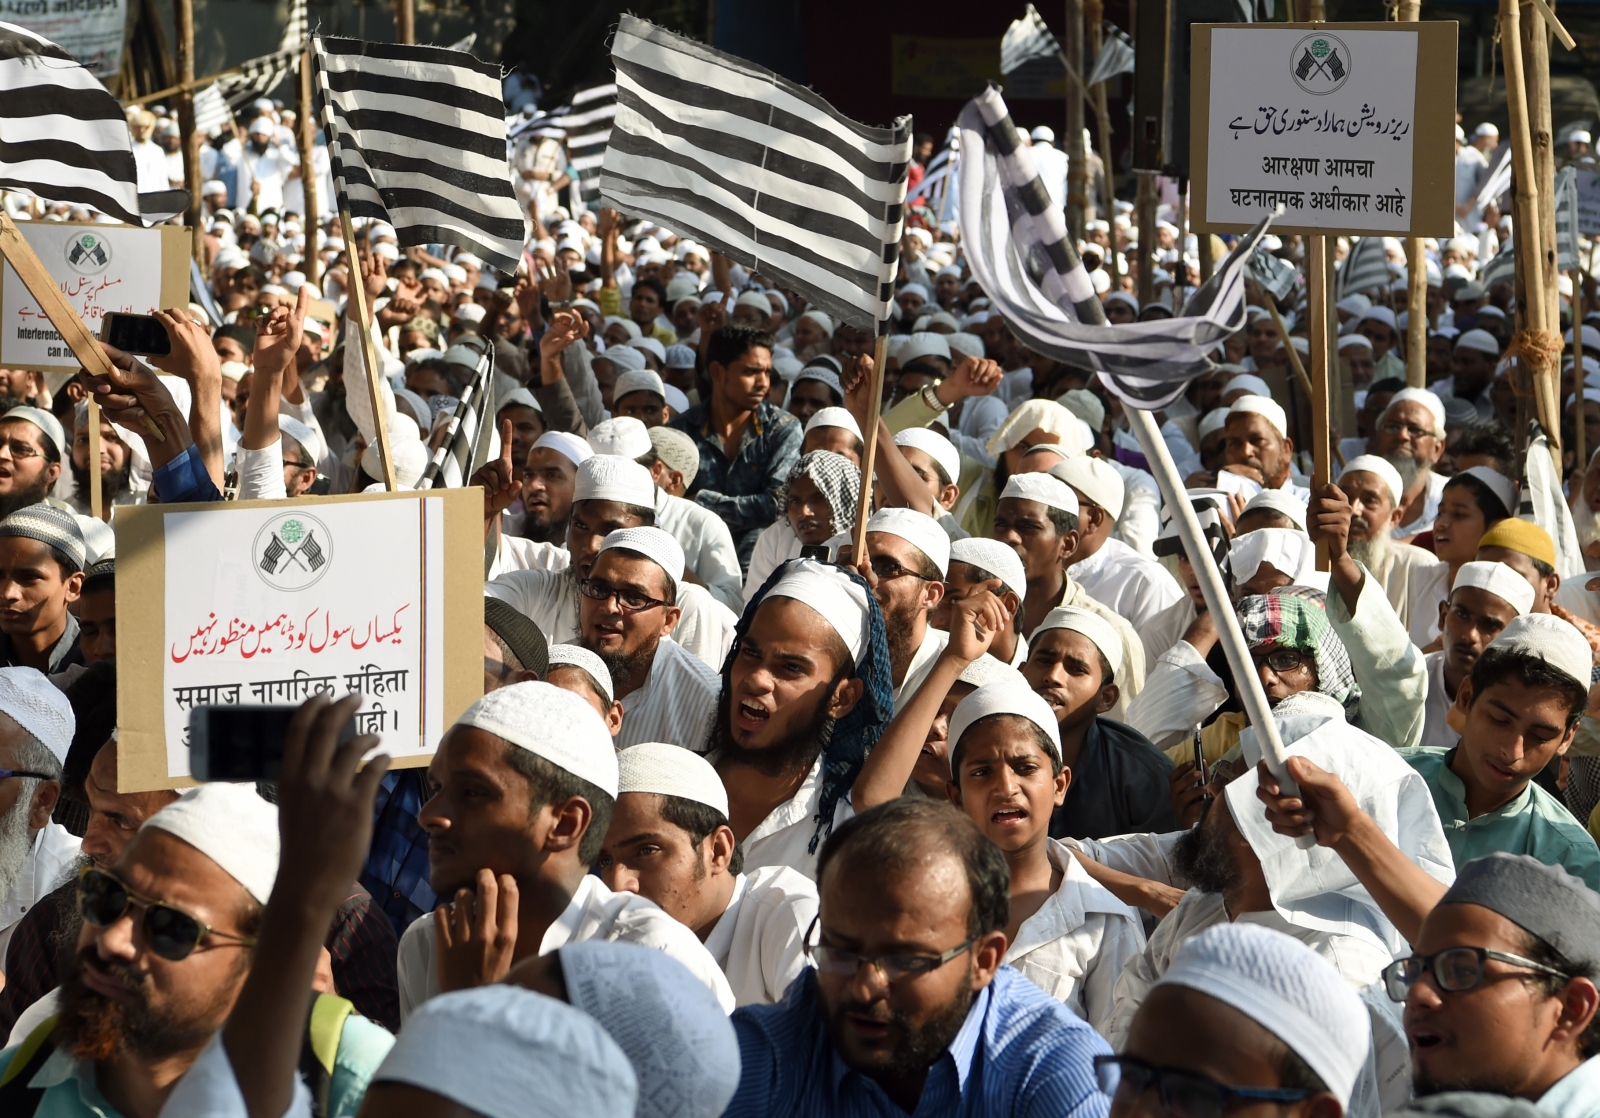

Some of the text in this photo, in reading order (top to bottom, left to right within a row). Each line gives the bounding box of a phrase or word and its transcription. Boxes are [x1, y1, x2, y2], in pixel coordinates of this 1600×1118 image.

[1228, 103, 1410, 141] ریزرویشن ہمارا دستوری حق ہے
[1261, 156, 1375, 180] आरक्षण आमचा
[1309, 186, 1371, 212] अधीकार
[1375, 187, 1406, 216] आहे
[94, 275, 122, 301] مسلم
[48, 346, 61, 357] can
[171, 603, 411, 664] یکساں سول کوڈ ہمیں منظور نہیں
[172, 663, 409, 711] समाज नागरिक संहिता
